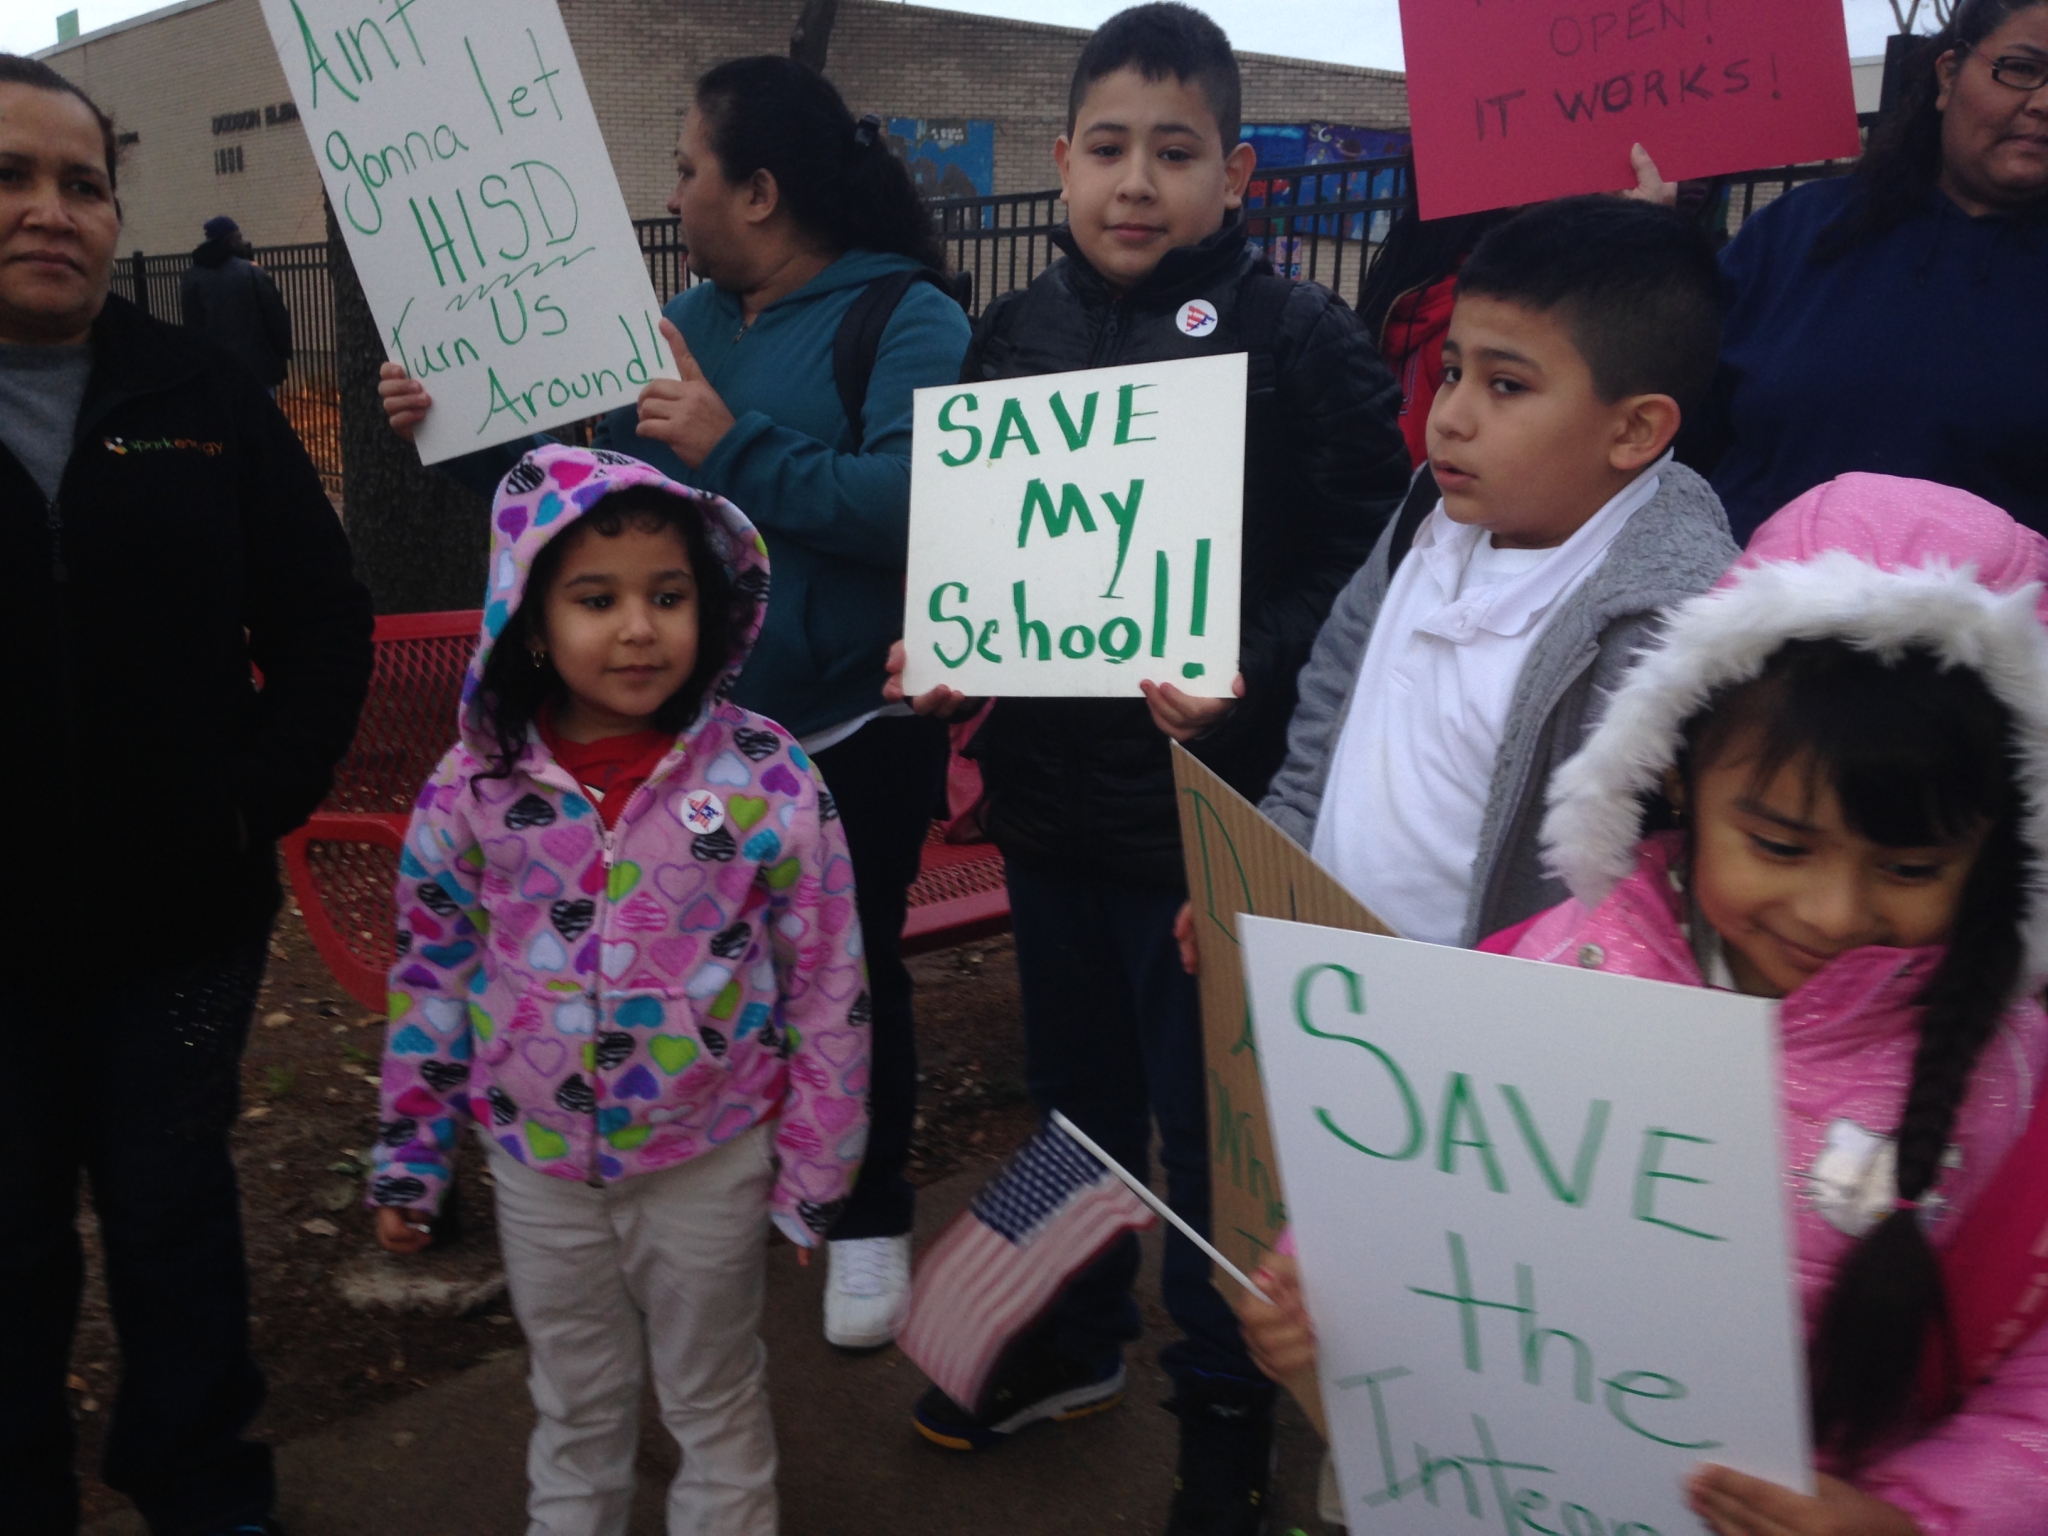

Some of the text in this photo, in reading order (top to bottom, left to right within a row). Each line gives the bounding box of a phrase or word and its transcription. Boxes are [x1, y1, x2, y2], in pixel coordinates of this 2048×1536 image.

[1550, 0, 1712, 56] OPEN!
[325, 28, 563, 236] gonna let
[1474, 53, 1783, 141] IT WORKS!
[409, 160, 578, 287] HISD
[391, 297, 479, 380] Turn
[937, 383, 1159, 468] SAVE
[928, 538, 1211, 679] School!
[1291, 961, 1731, 1243] SAVE
[1405, 1229, 1725, 1449] the
